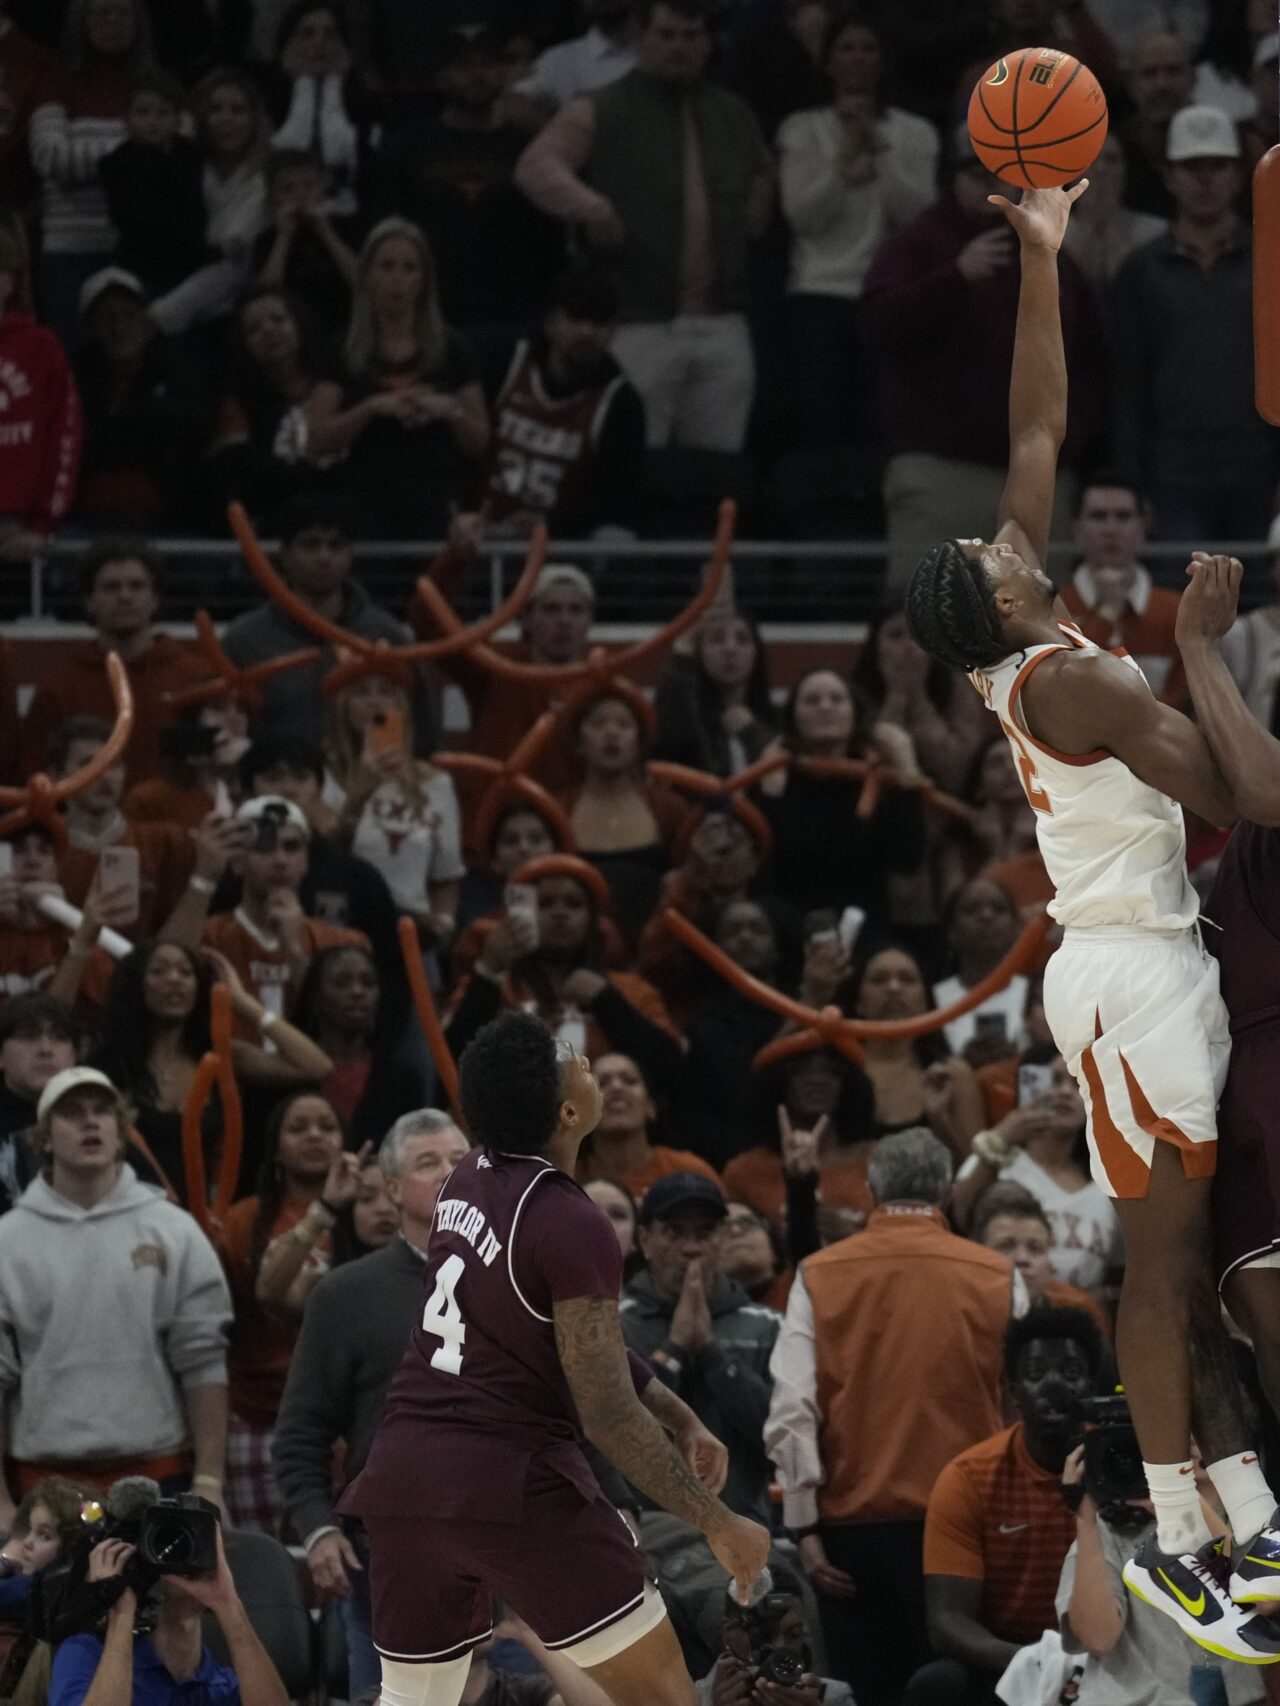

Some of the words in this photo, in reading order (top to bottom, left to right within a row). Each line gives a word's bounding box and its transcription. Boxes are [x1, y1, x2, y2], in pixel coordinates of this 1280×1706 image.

[436, 1199, 487, 1248] TAYLOR
[476, 1226, 502, 1268] IV
[422, 1253, 466, 1376] 4
